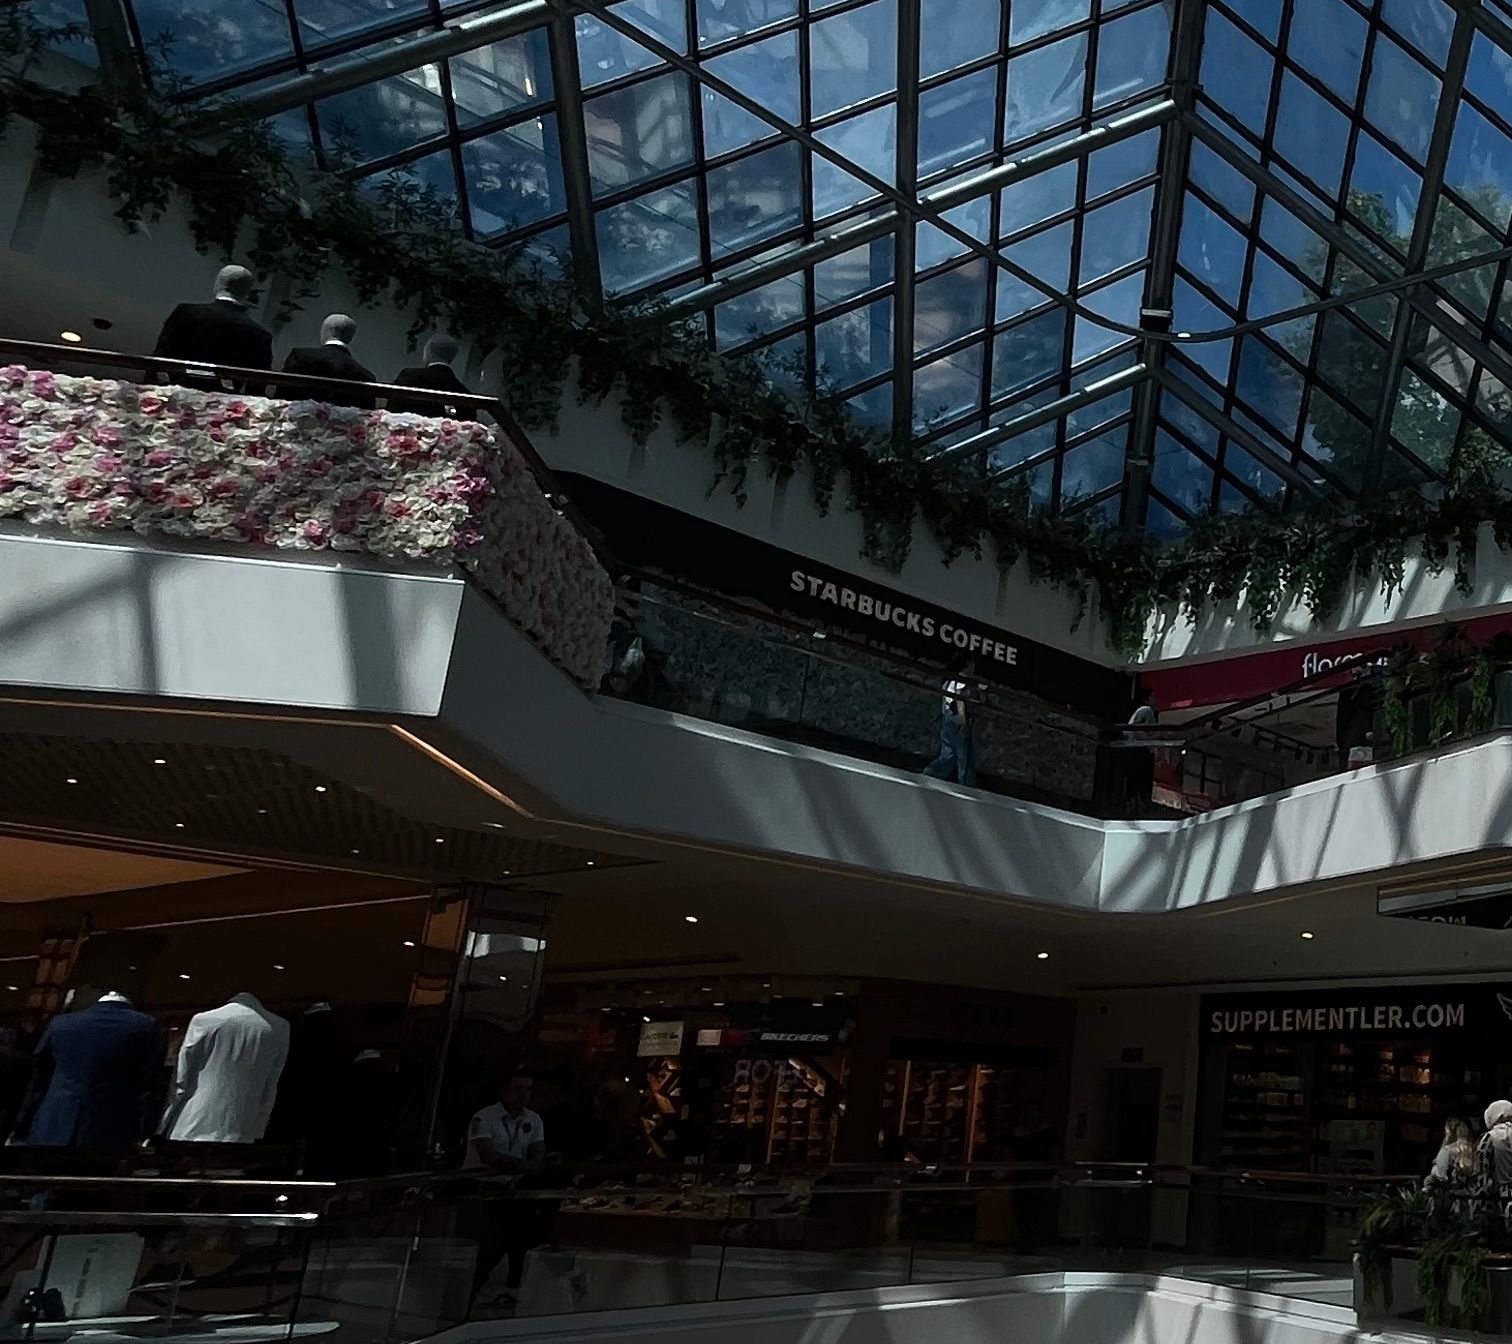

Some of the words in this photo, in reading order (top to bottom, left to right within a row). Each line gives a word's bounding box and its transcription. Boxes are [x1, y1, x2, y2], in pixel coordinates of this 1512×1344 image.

[788, 569, 935, 638] STARBUCKS
[938, 623, 1019, 666] COFFEE
[1210, 1003, 1466, 1034] SUPPLEMENTLER.COM
